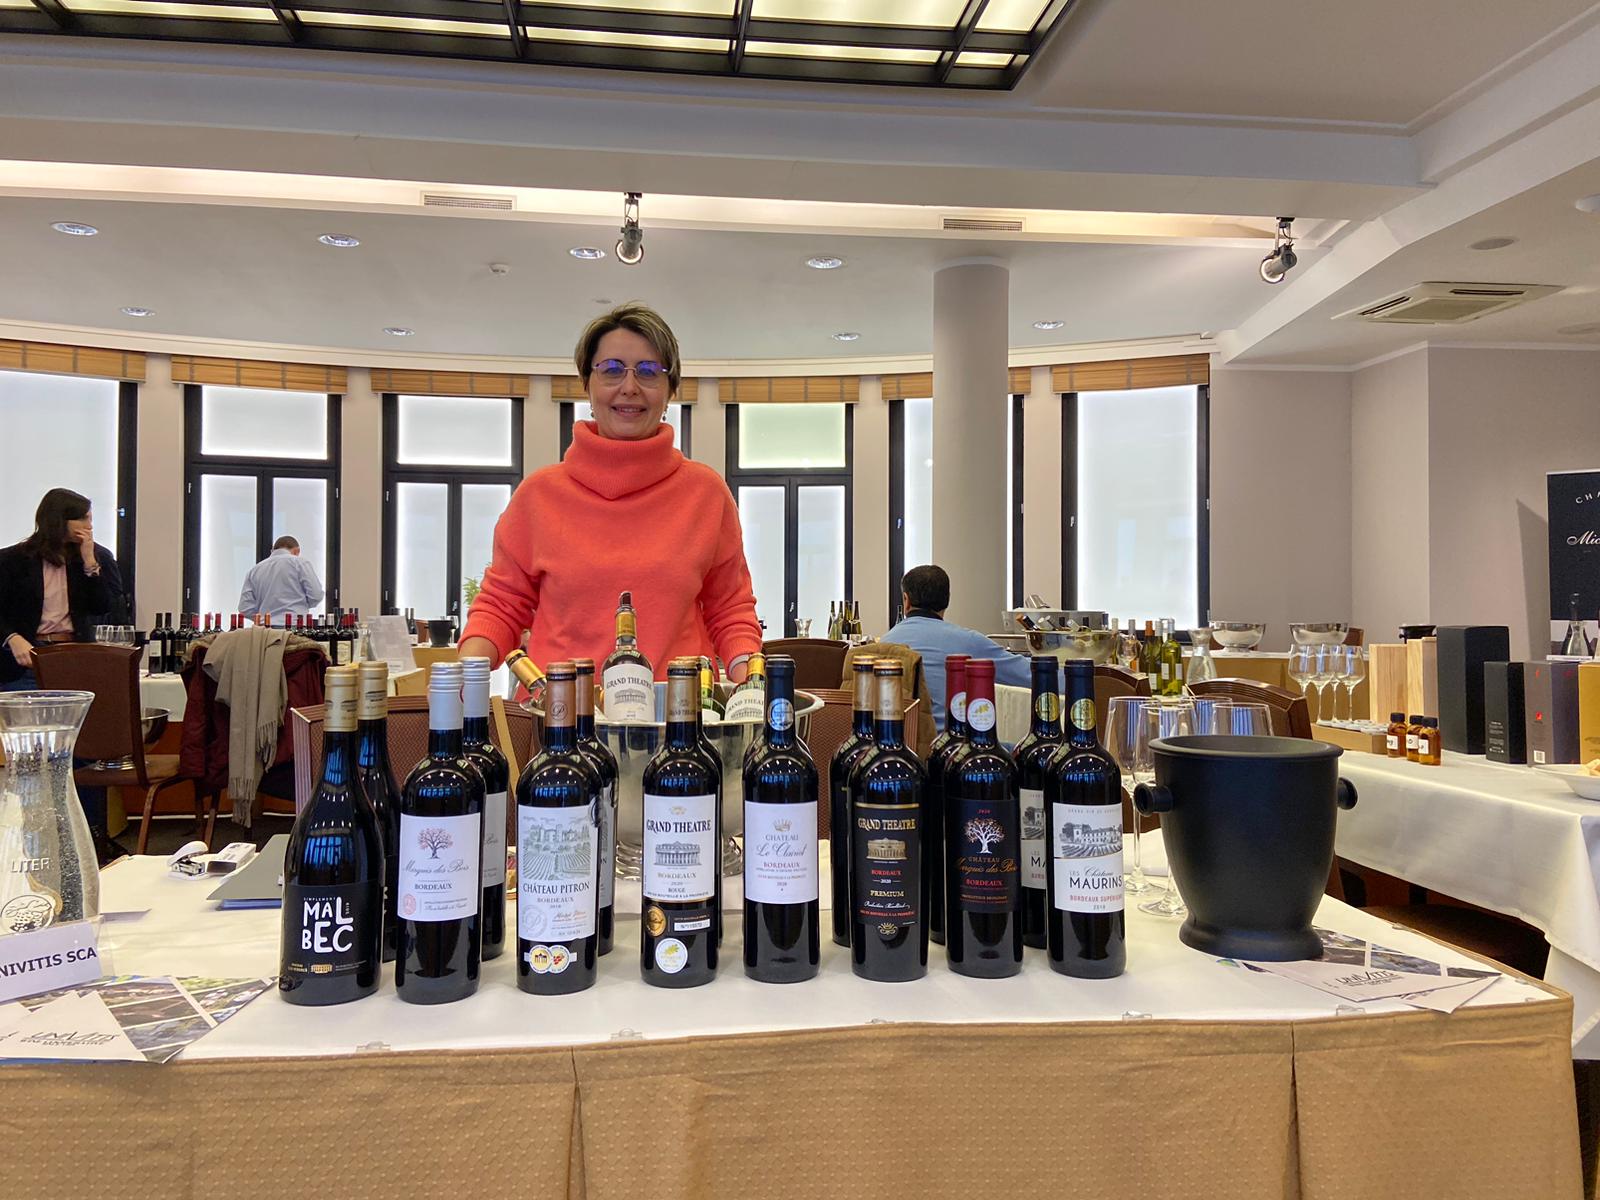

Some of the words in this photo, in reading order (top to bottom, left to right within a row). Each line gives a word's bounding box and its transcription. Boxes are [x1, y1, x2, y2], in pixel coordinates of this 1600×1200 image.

[606, 678, 626, 690] GRAND
[647, 819, 671, 833] GRAND
[673, 819, 711, 833] THEATRE
[858, 818, 881, 831] GRAND
[882, 819, 916, 831] THEATRE
[11, 857, 51, 873] LITER
[871, 869, 902, 877] BORDEAUX
[415, 882, 453, 890] BORDEAUX
[560, 881, 590, 894] PITRON
[966, 879, 1003, 887] BORDEAUX
[1069, 875, 1122, 890] MAURINS
[1070, 894, 1099, 902] BORDEAUX
[303, 896, 354, 927] MAL
[301, 921, 354, 953] BEC
[66, 946, 97, 964] SCA
